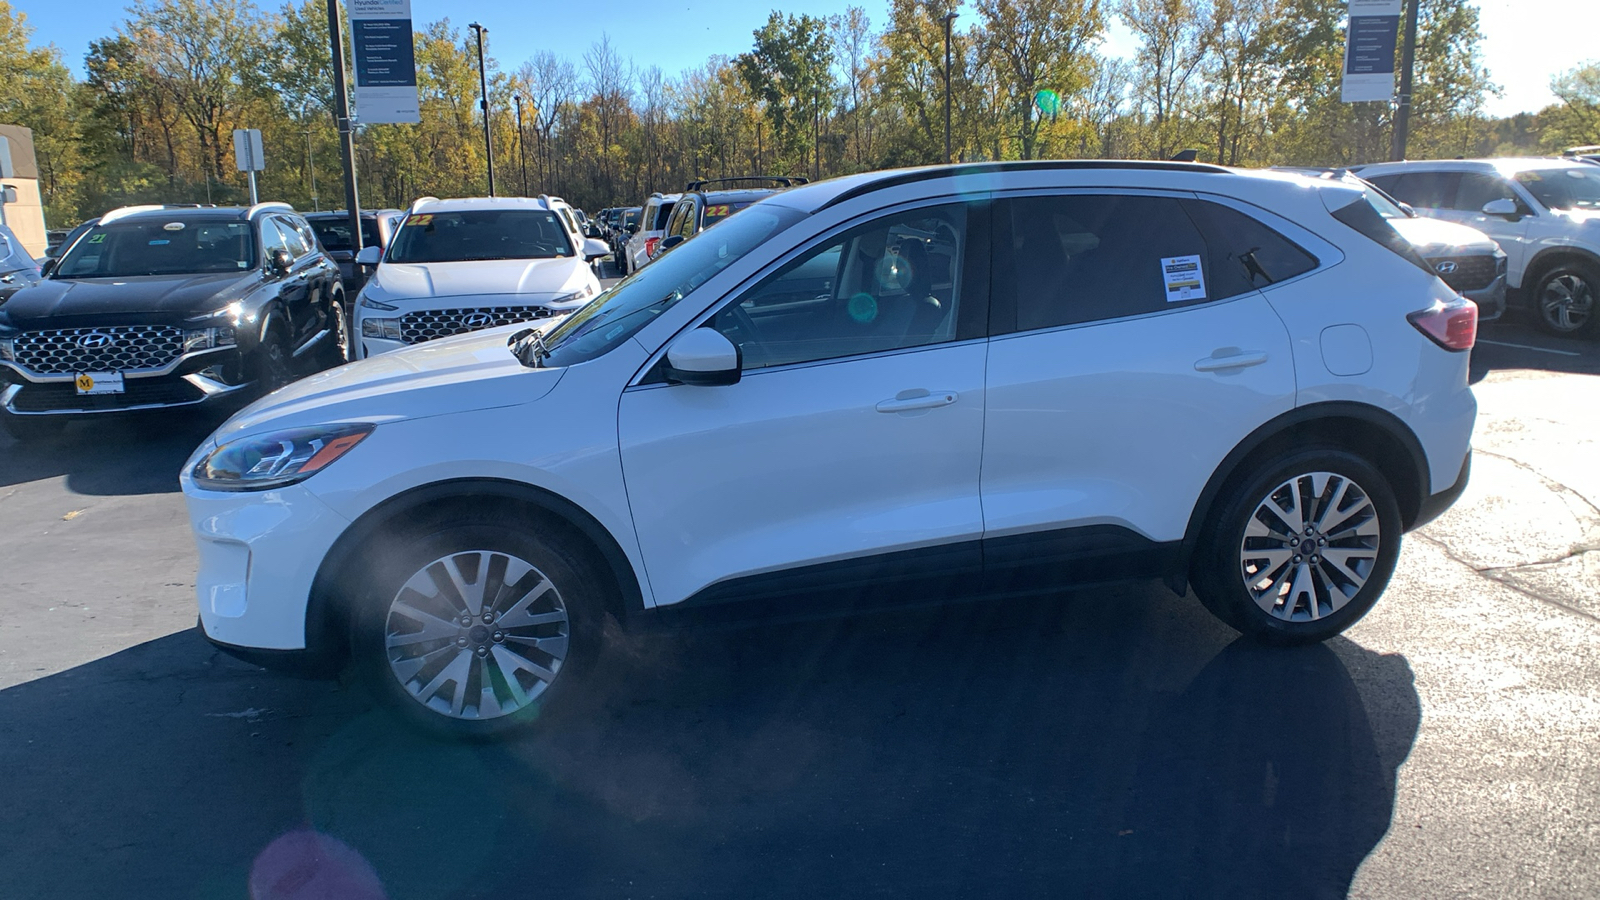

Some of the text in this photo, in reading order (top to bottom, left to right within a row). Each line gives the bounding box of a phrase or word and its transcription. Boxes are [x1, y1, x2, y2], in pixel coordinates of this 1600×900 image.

[705, 206, 728, 217] 22
[407, 214, 433, 226] 22
[88, 234, 106, 243] 21
[80, 379, 90, 388] M
